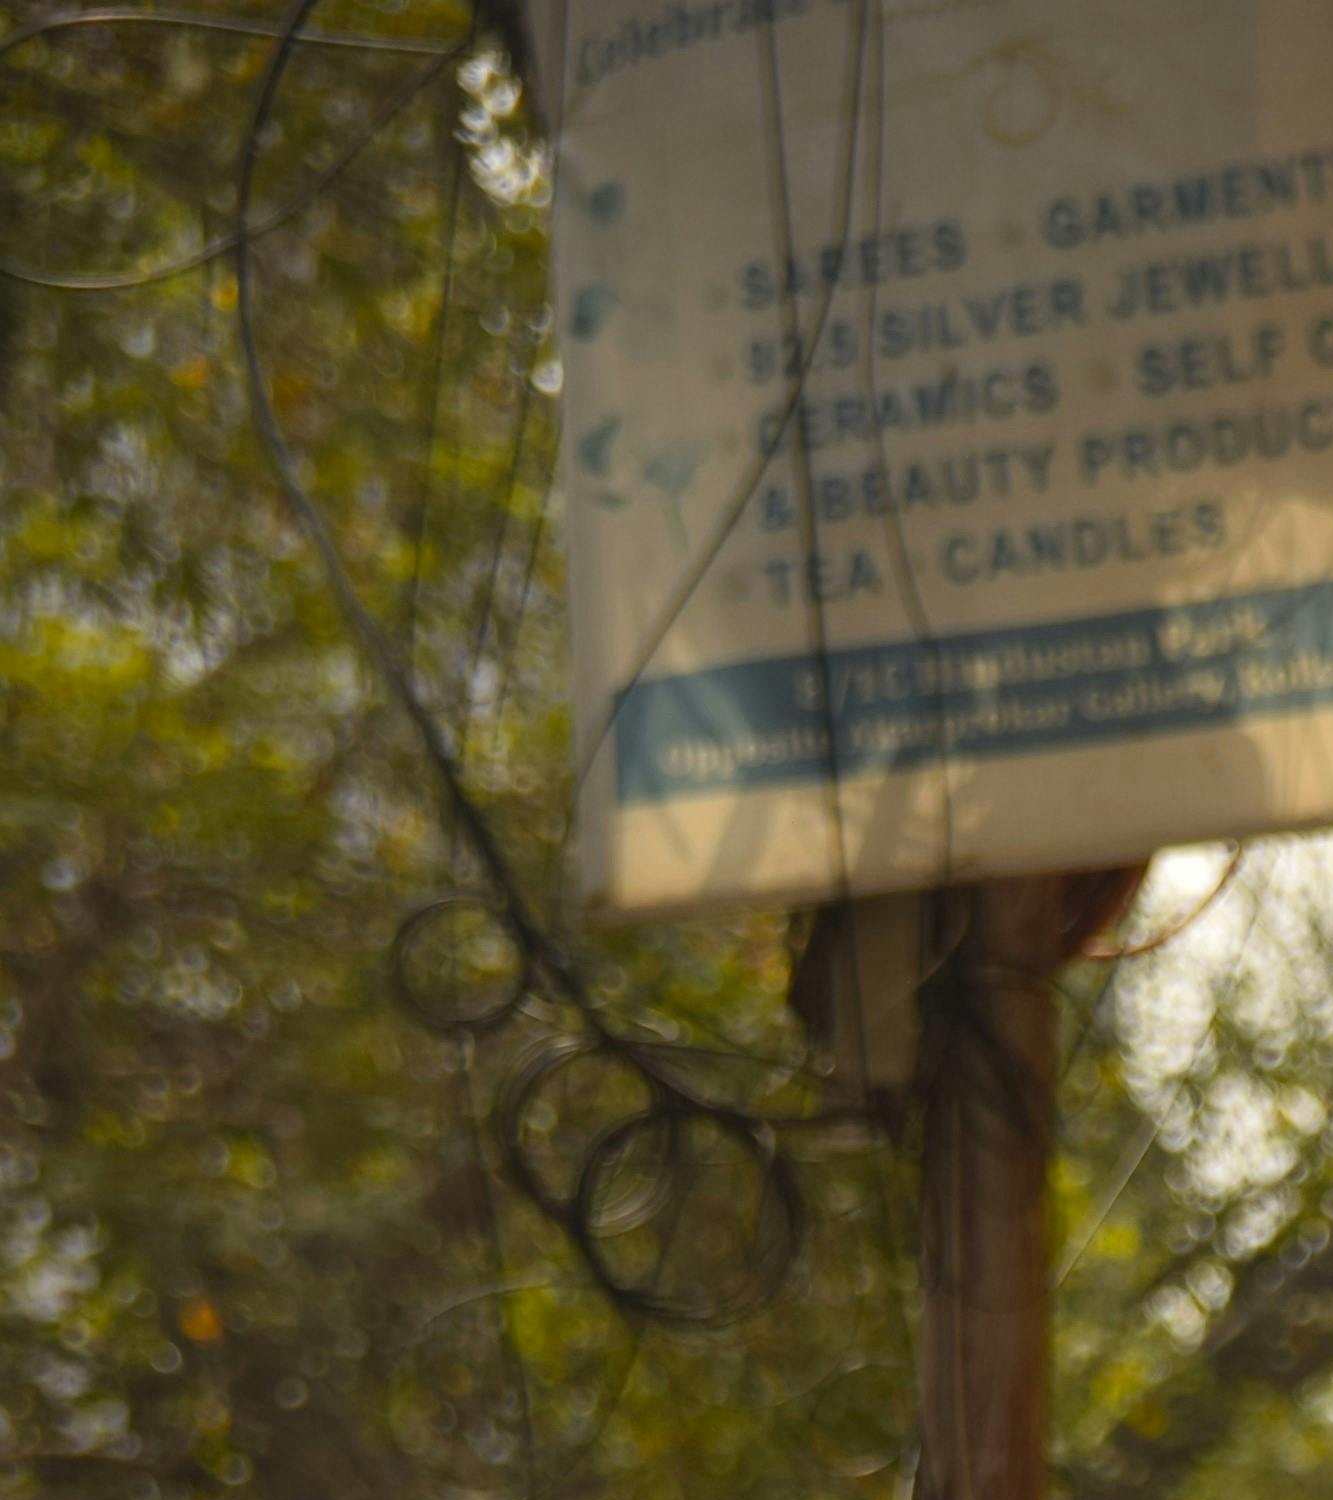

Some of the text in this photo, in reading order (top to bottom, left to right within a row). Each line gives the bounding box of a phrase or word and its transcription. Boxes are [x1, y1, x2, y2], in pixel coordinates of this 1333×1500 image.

[742, 218, 967, 311] SAREES
[882, 280, 1086, 359] SILVER
[758, 363, 1058, 454] CERAMICS
[1138, 323, 1284, 396] SELF
[761, 486, 793, 532] &
[820, 443, 1055, 523] BEAUTY
[764, 502, 1226, 608] TEA CANDLES
